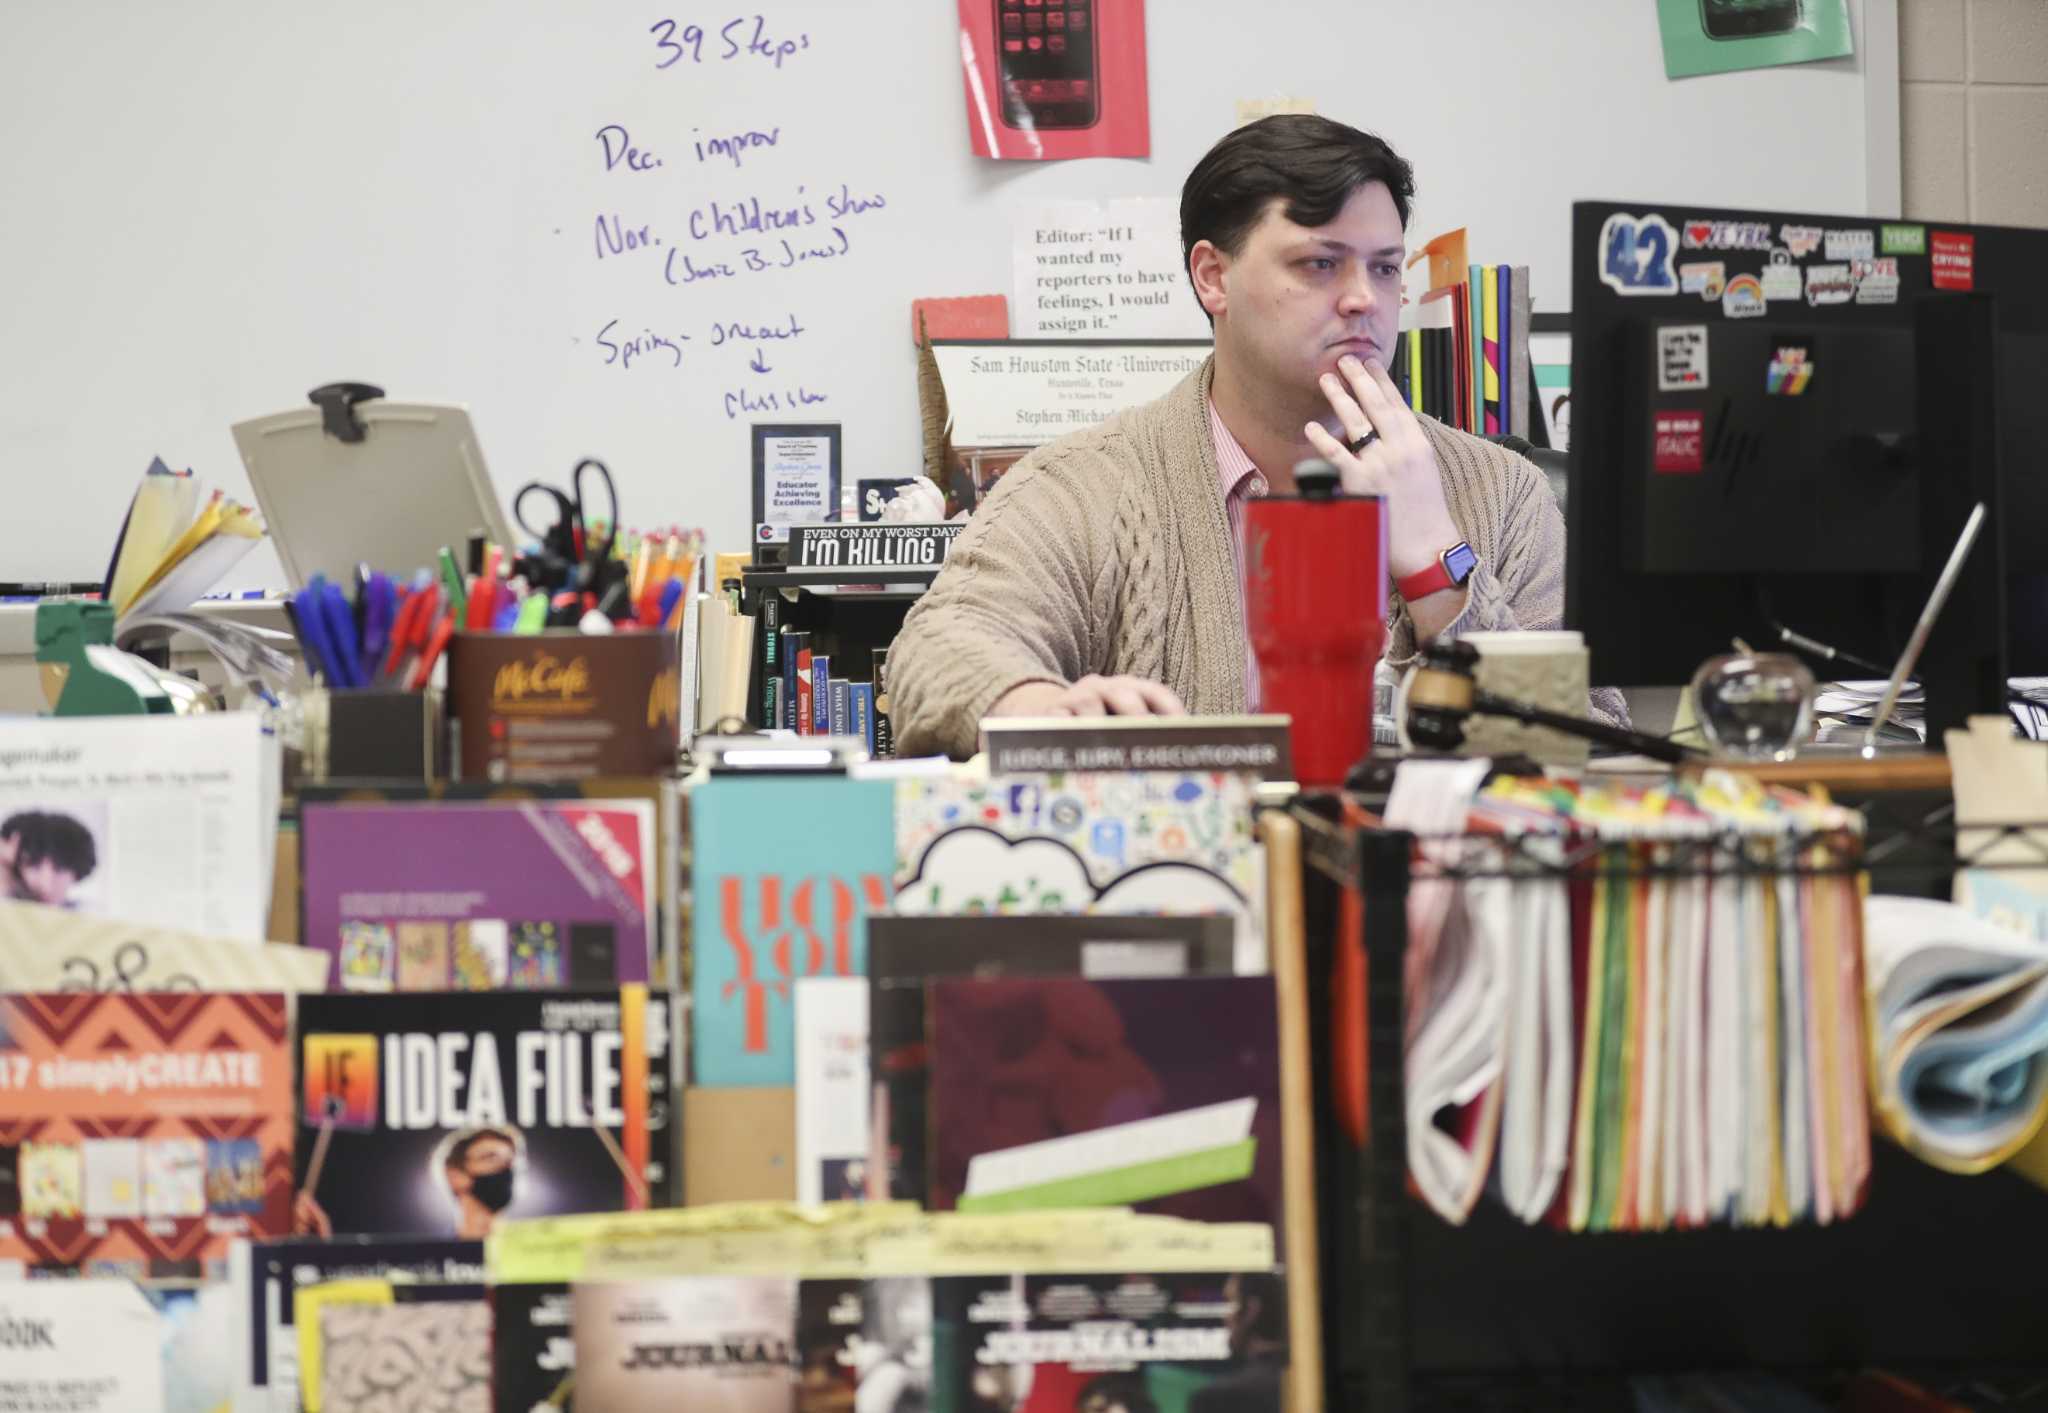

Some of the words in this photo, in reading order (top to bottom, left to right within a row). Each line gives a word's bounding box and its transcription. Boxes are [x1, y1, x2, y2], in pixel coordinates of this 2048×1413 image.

[649, 18, 704, 69] 39
[721, 14, 810, 69] Steps
[595, 124, 663, 172] Dec.
[594, 214, 661, 260] Nov.
[1035, 228, 1093, 245] Editor:
[1126, 227, 1134, 242] I
[740, 248, 773, 272] B.
[1036, 249, 1094, 265] wanted
[1099, 251, 1124, 267] my
[1036, 271, 1112, 289] reporters
[1116, 272, 1133, 285] to
[1138, 270, 1176, 285] have
[1037, 293, 1104, 311] feelings,
[1107, 293, 1116, 307] I
[1120, 291, 1171, 306] would
[1038, 316, 1088, 333] assign
[969, 356, 1004, 374] Sam
[1007, 355, 1071, 374] Houston
[1075, 355, 1113, 374] State
[1015, 408, 1063, 425] Stephen
[1066, 408, 1114, 425] Micha
[774, 490, 820, 499] Achieving
[776, 481, 818, 489] Educator
[773, 499, 822, 507] Excellence
[803, 528, 837, 539] EVEN
[840, 528, 857, 539] ON
[861, 528, 883, 539] MY
[884, 527, 931, 539] WORST
[801, 538, 841, 566] I'M
[847, 537, 936, 565] KILLING
[767, 631, 776, 664] STOVALL
[765, 676, 777, 709] Writing
[834, 685, 843, 712] WHAT
[857, 697, 866, 712] THE
[1130, 743, 1279, 767] EXECUTIONER
[38, 1051, 261, 1094] simplyCREATE
[383, 1031, 507, 1130] IDEA
[515, 1030, 625, 1128] FILE
[975, 1327, 1232, 1366] JOURNALISM
